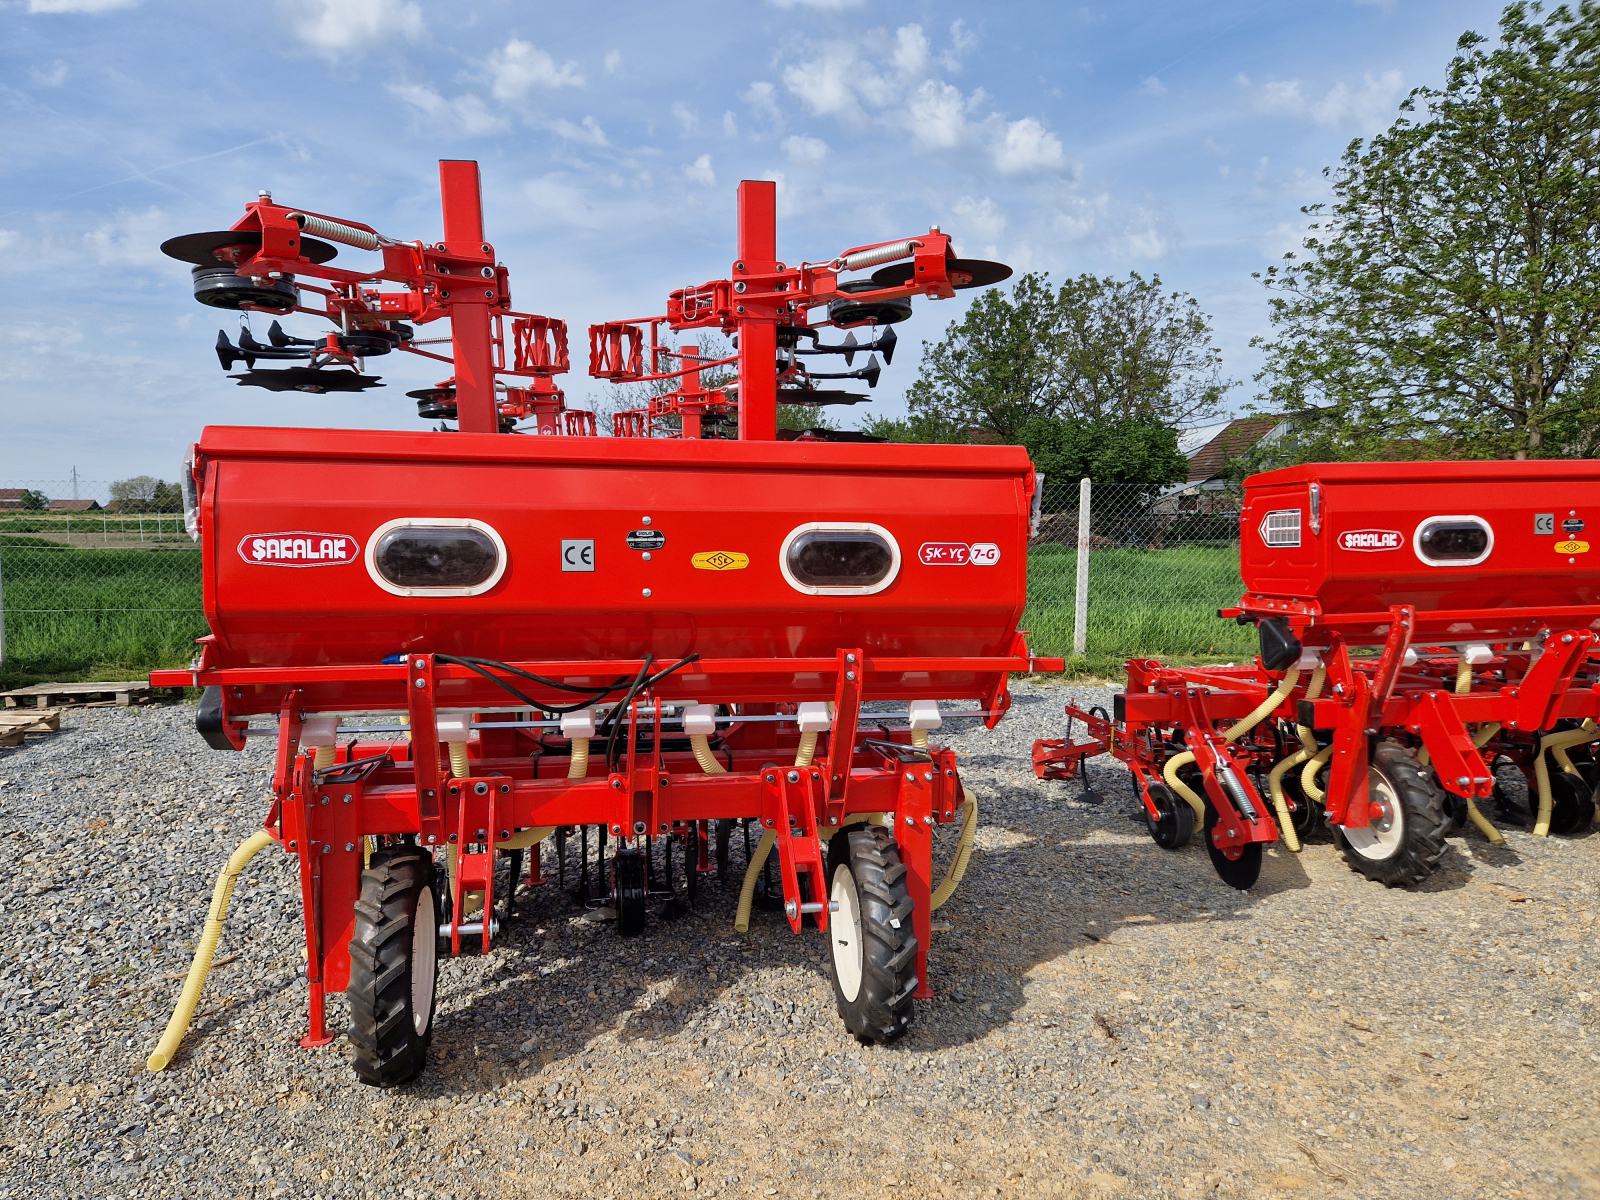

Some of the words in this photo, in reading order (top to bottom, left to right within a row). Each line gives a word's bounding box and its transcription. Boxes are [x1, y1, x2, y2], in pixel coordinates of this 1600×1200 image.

[1536, 517, 1553, 530] CE
[252, 538, 346, 561] ŞAKALAK
[564, 545, 592, 565] CE
[974, 548, 995, 560] 7-G
